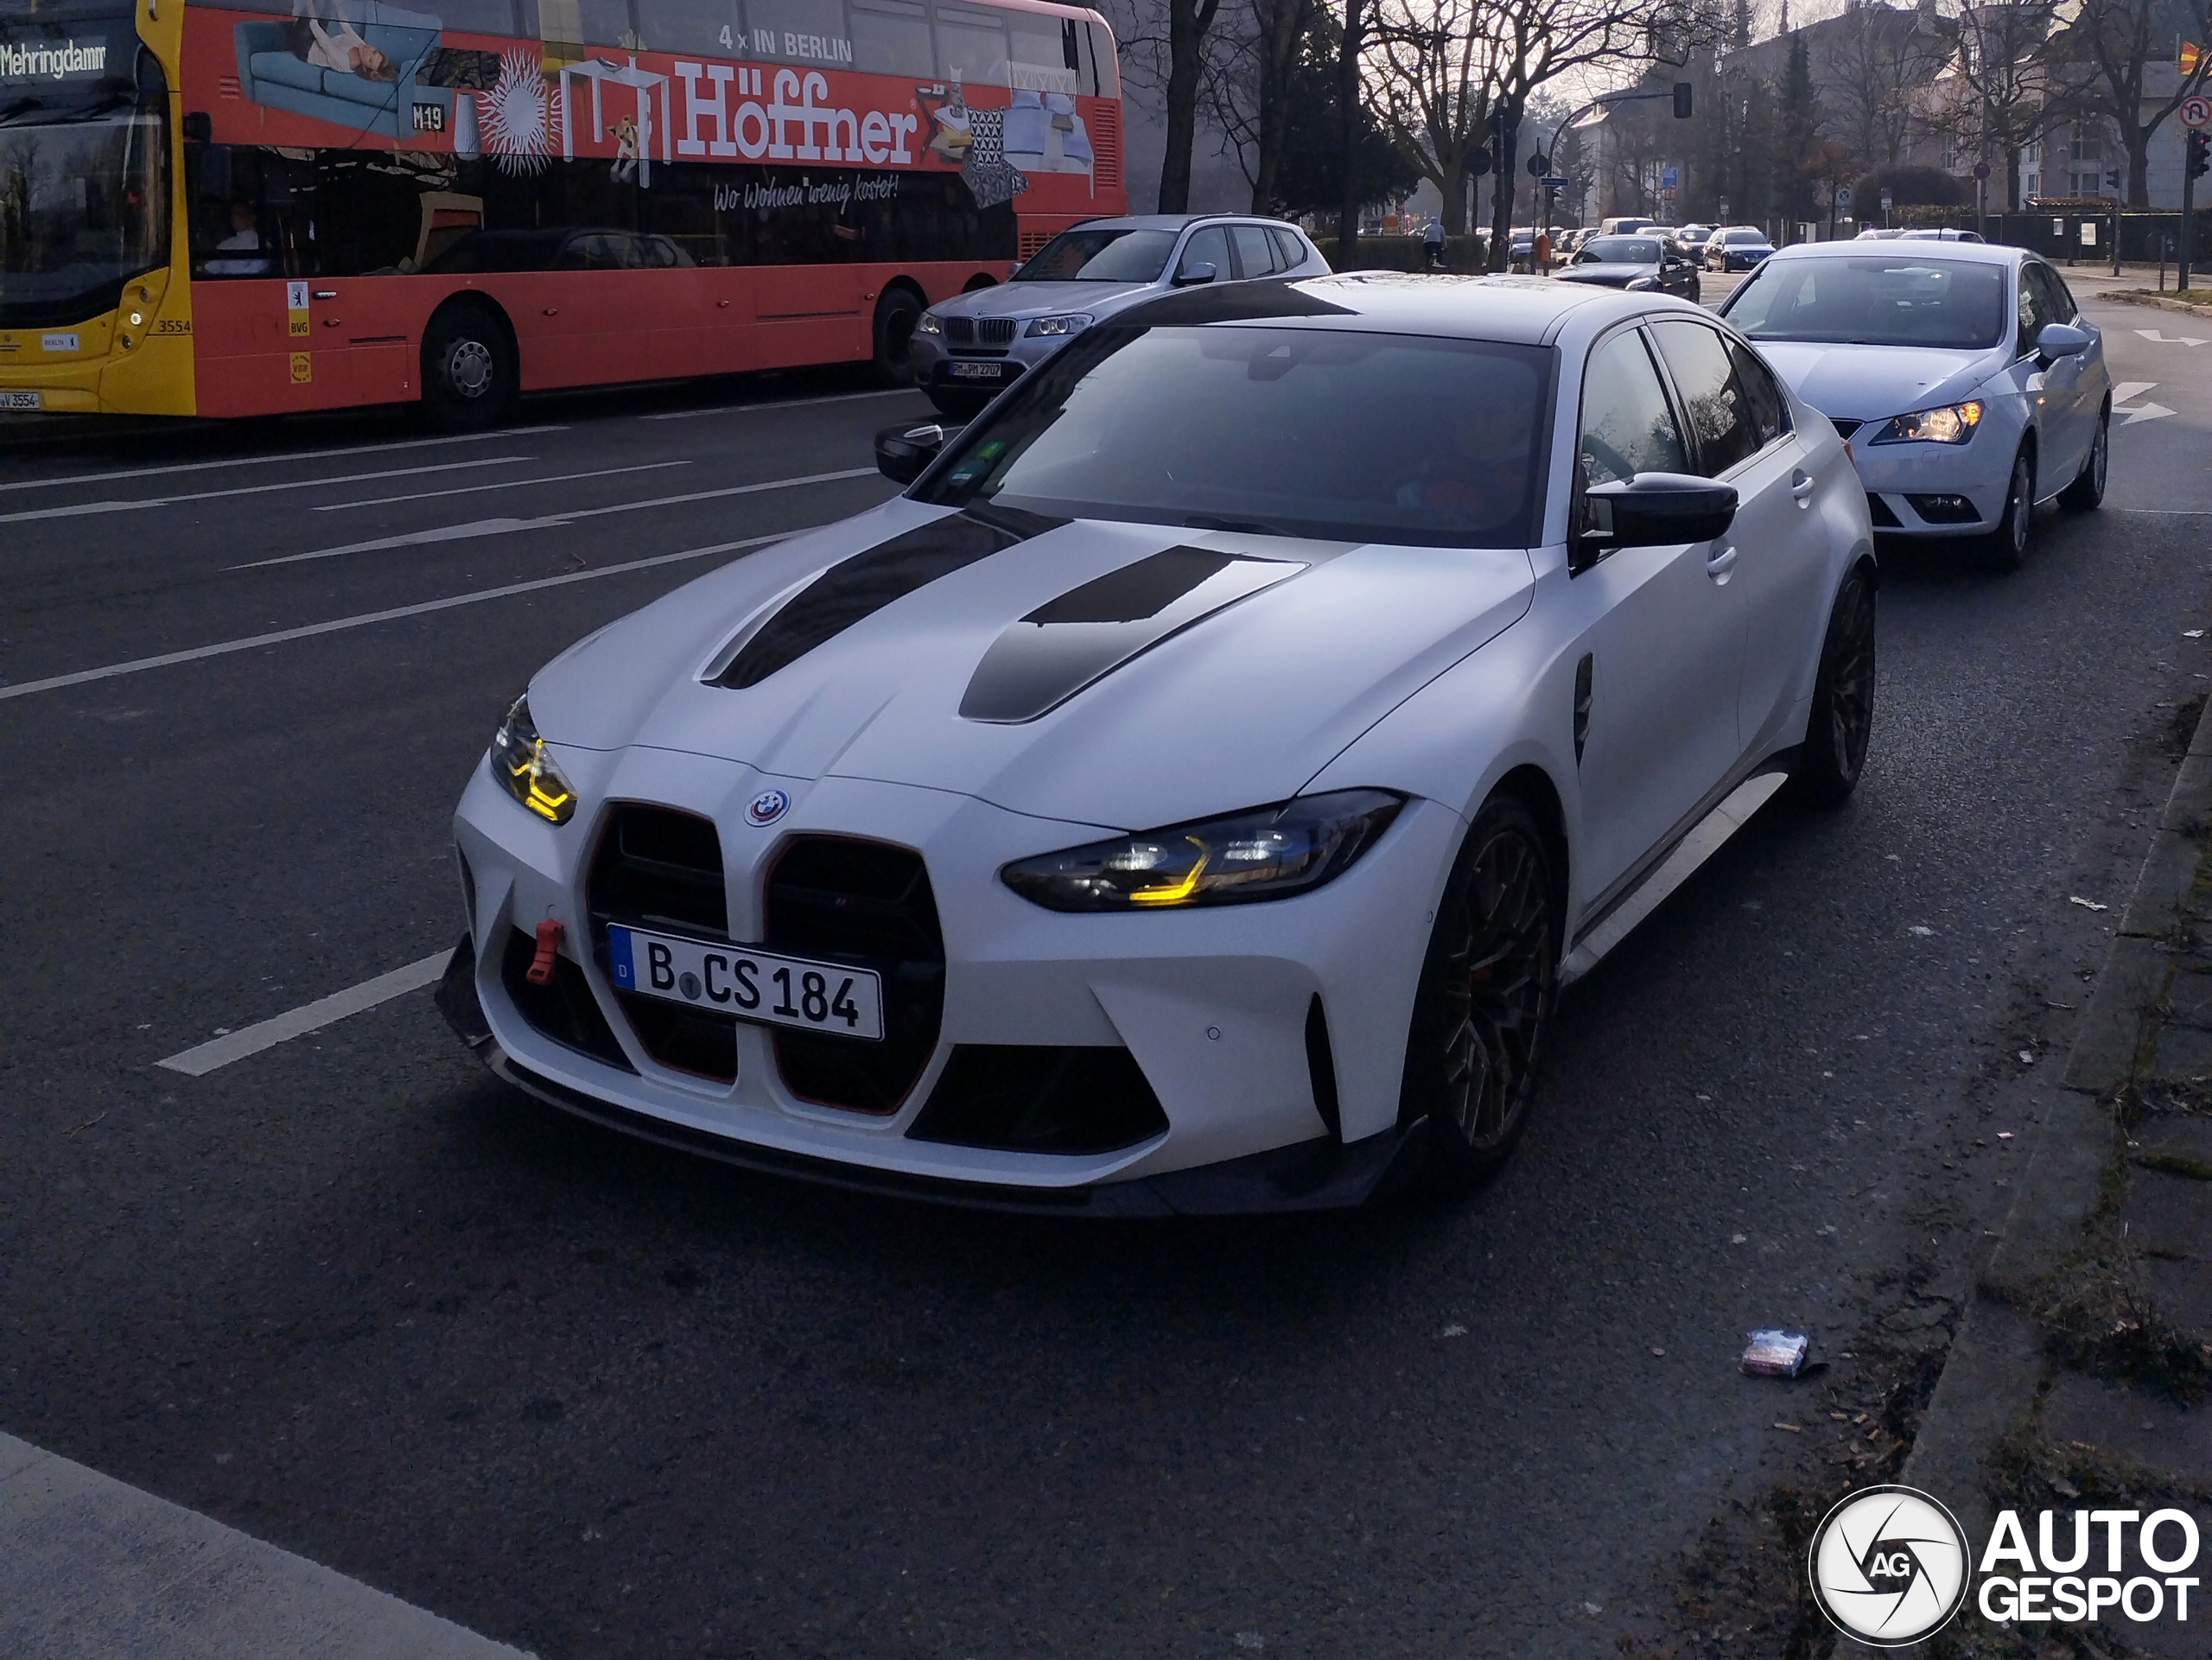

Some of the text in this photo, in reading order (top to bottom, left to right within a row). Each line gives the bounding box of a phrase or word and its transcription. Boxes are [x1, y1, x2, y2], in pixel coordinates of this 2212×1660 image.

[0, 39, 106, 80] Mehringdamm
[719, 24, 853, 62] 4 x IN BERLIN
[413, 105, 442, 130] M19
[674, 61, 918, 164] Höffner
[714, 174, 899, 215] Wo Wohnen wenig kostet!
[159, 320, 191, 333] 3554
[290, 321, 308, 334] BVG
[618, 964, 627, 977] D
[648, 942, 859, 1027] B CS 184
